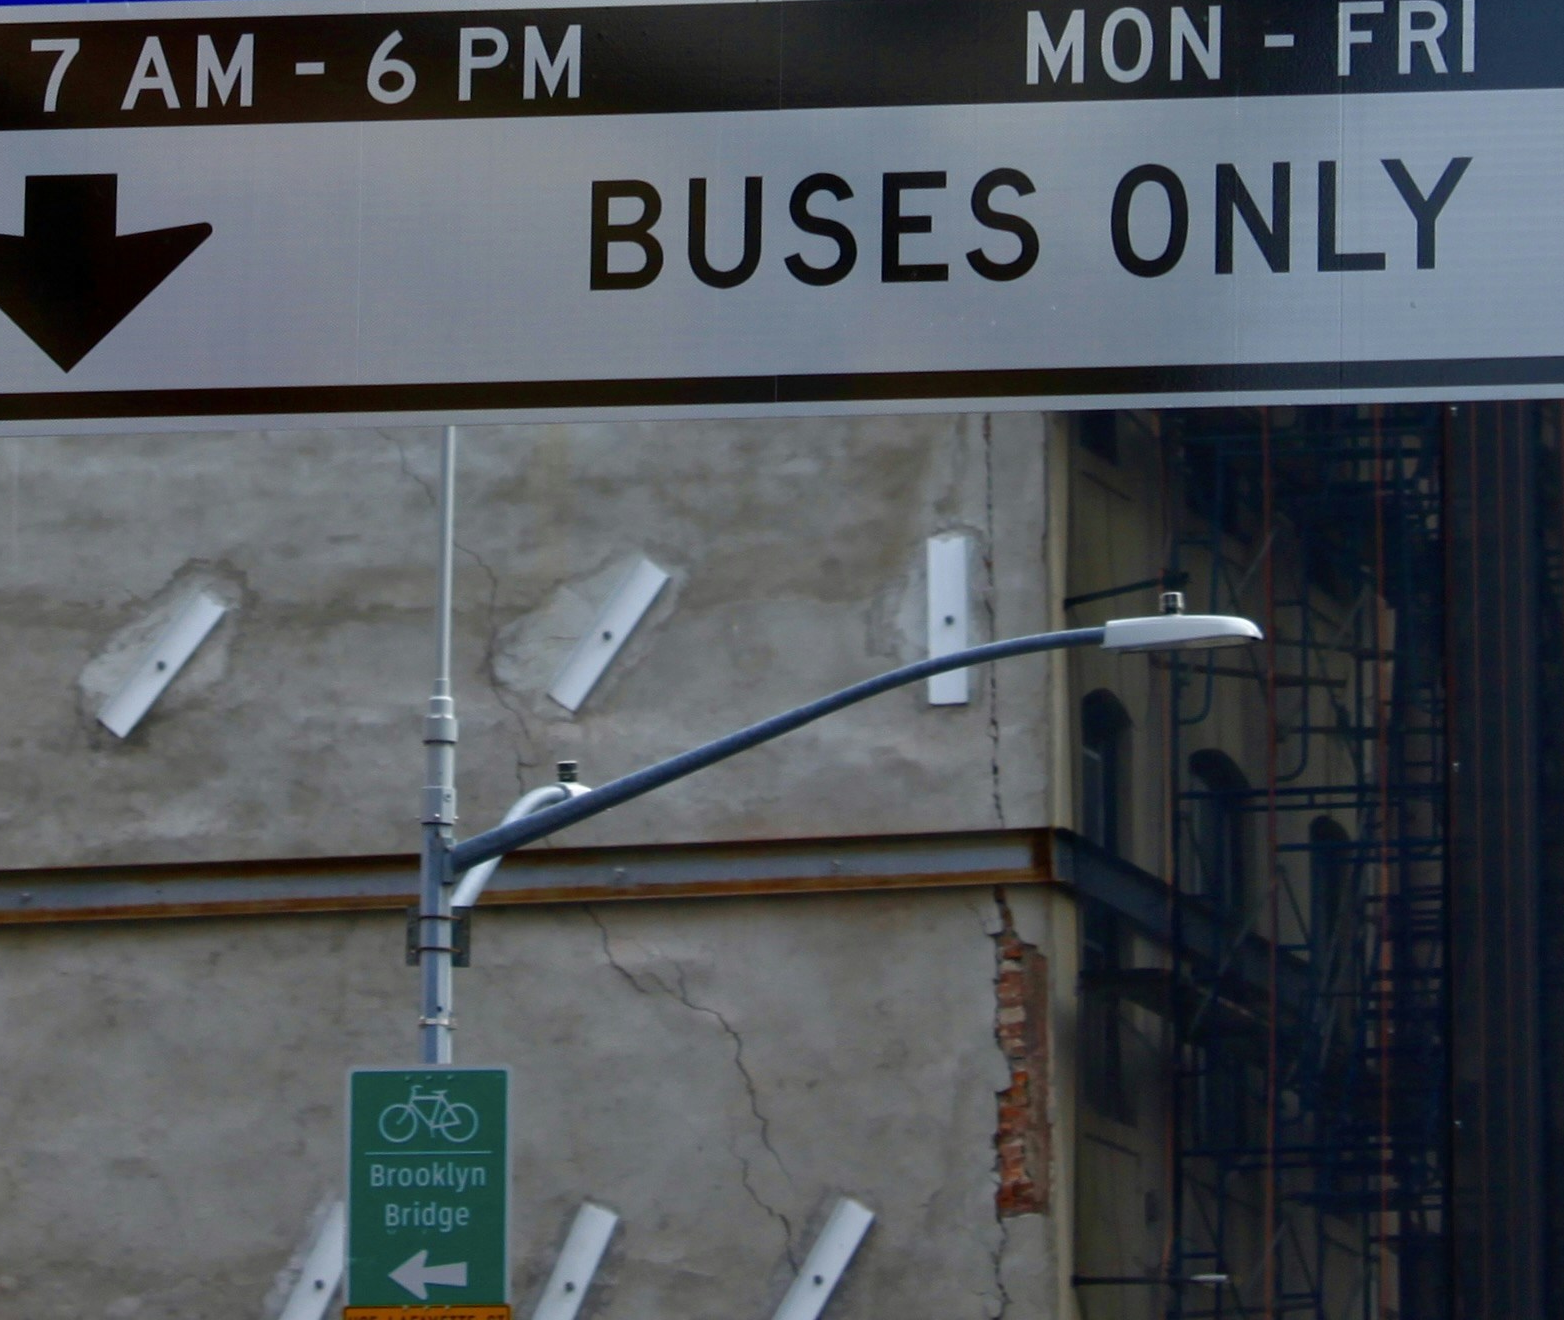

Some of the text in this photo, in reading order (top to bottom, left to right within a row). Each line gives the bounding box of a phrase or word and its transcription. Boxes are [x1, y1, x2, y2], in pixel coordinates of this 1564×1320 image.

[30, 24, 582, 113] 7 AM - 6 PM
[1026, 5, 1221, 85] MON
[1264, 34, 1295, 48] -
[589, 157, 1472, 291] BUSES ONLY
[370, 1161, 486, 1193] Brooklyn
[385, 1201, 470, 1233] Bridge
